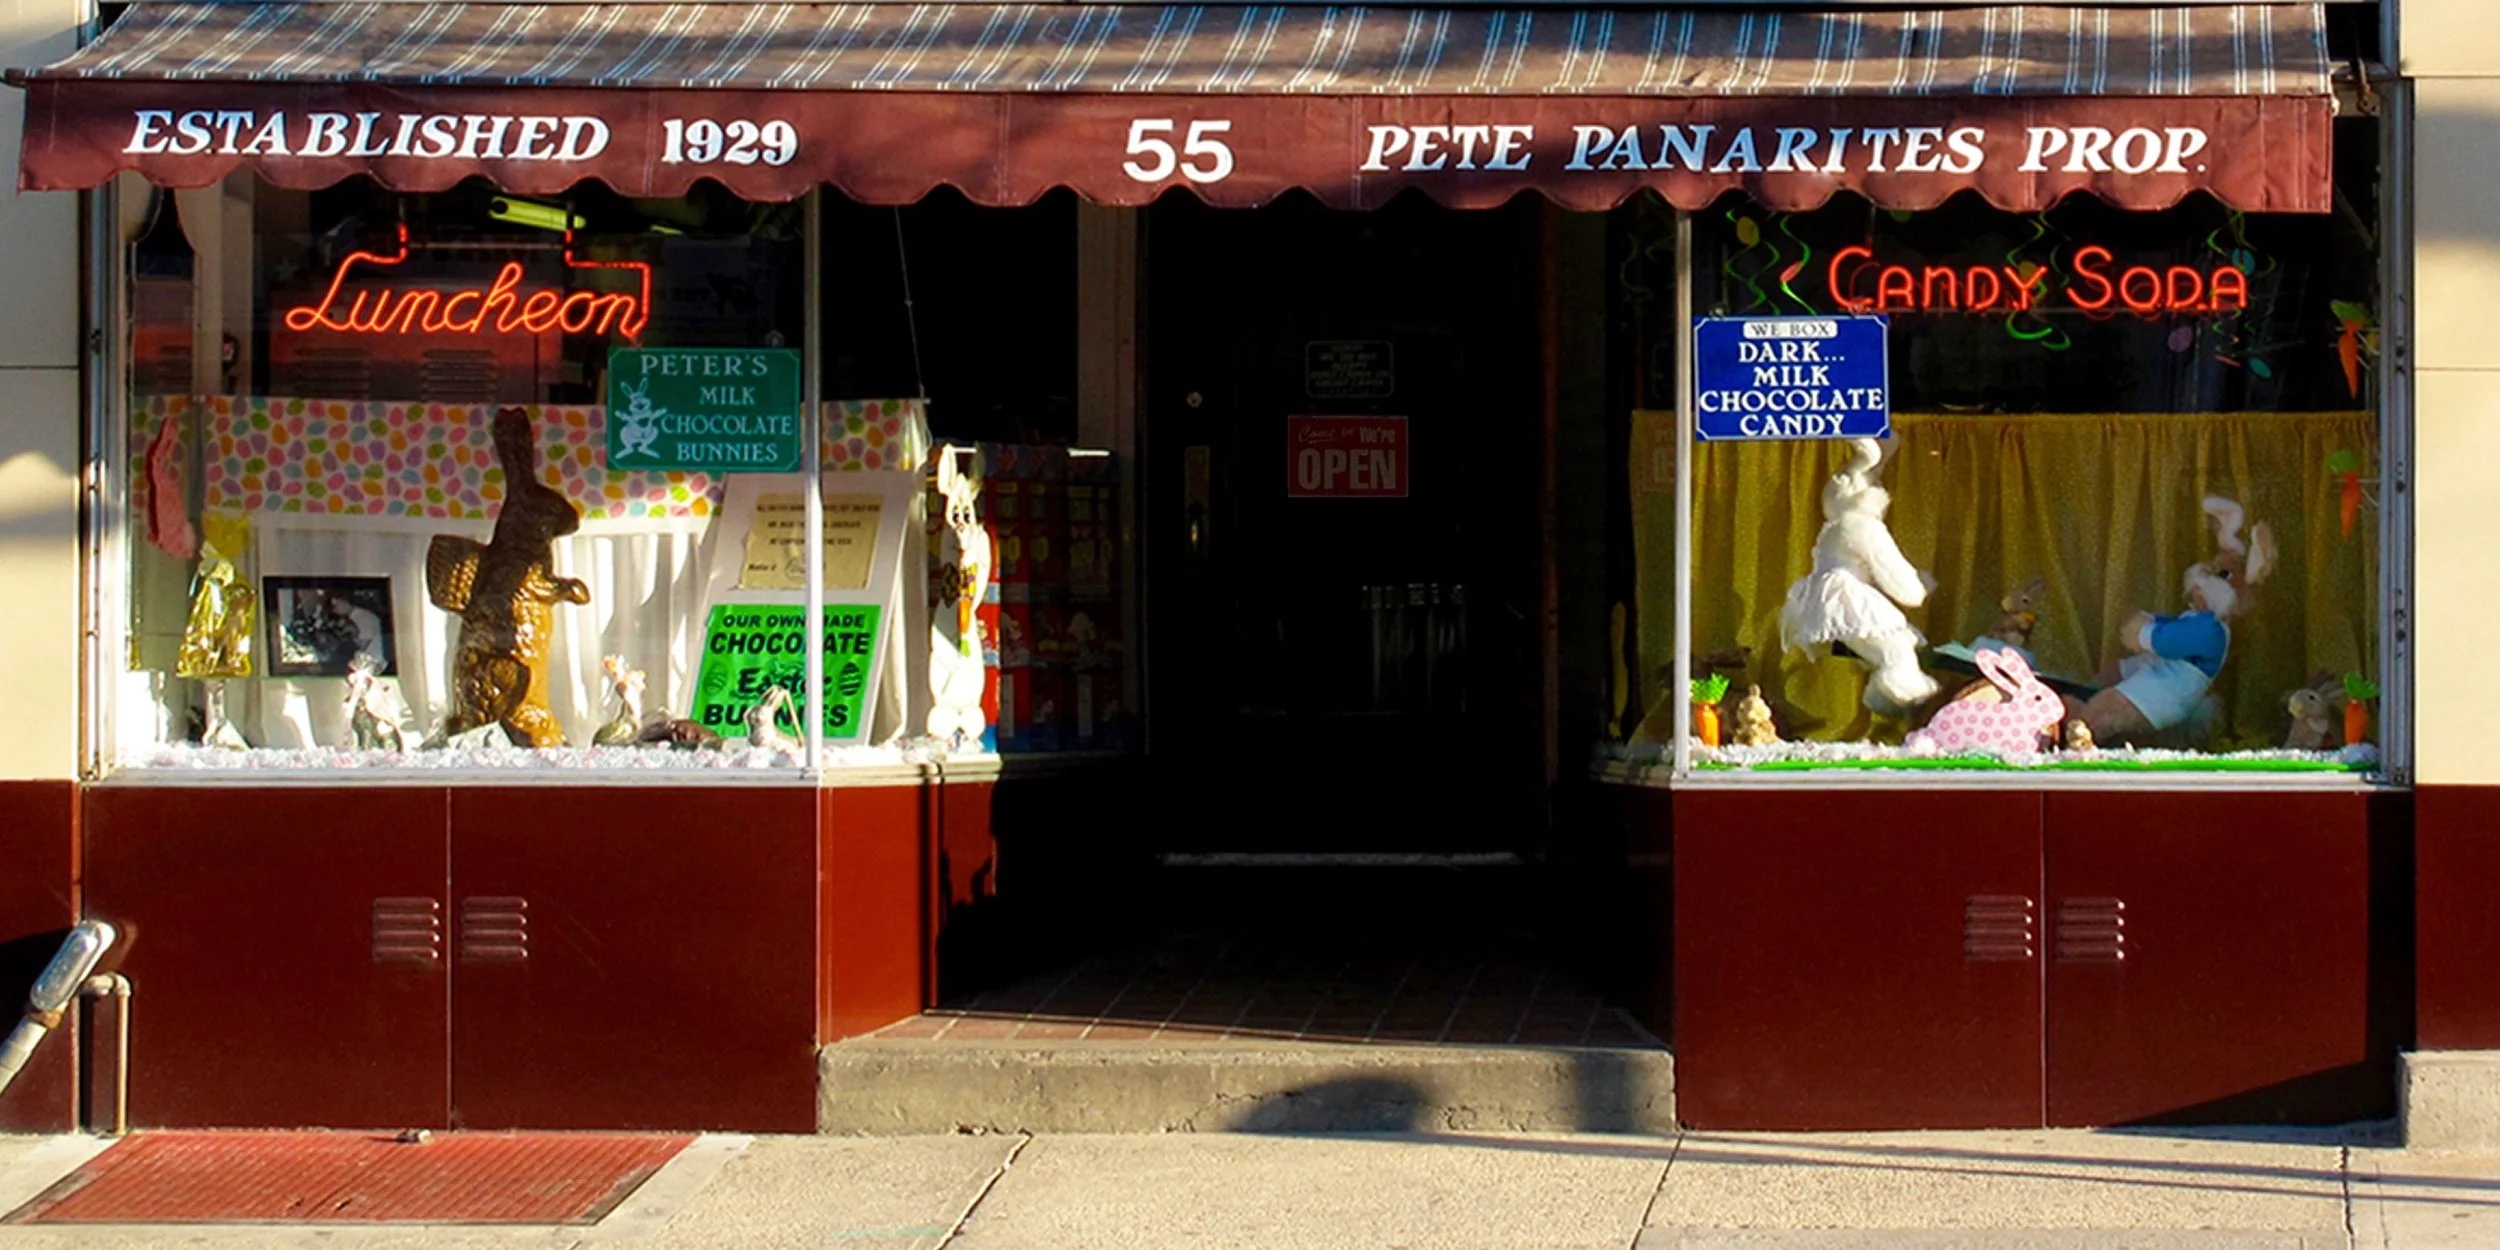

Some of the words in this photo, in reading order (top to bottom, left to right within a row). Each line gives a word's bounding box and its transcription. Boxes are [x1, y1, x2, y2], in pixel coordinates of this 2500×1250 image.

[121, 109, 610, 162] ESTABLISHED
[661, 118, 799, 166] 1929
[1360, 124, 1534, 172] PETE
[1564, 124, 1986, 174] PANARITES
[2017, 126, 2208, 174] PROP.
[1122, 118, 1235, 183] 55
[285, 250, 651, 339] Luncheon
[1751, 323, 1781, 337] WE
[1790, 322, 1831, 337] BOX
[1738, 341, 1846, 364] DARK...
[640, 354, 768, 377] PETER'S
[1752, 365, 1831, 388] MILK
[700, 385, 756, 406] MILK
[1699, 388, 1886, 413] CHOCOLATE
[660, 413, 793, 436] CHOCOLATE
[1739, 413, 1845, 437] CANDY
[676, 442, 779, 464] BUNNIES
[1297, 447, 1397, 491] OPEN
[722, 614, 761, 628] OUR
[709, 631, 871, 655] CHOCOATE
